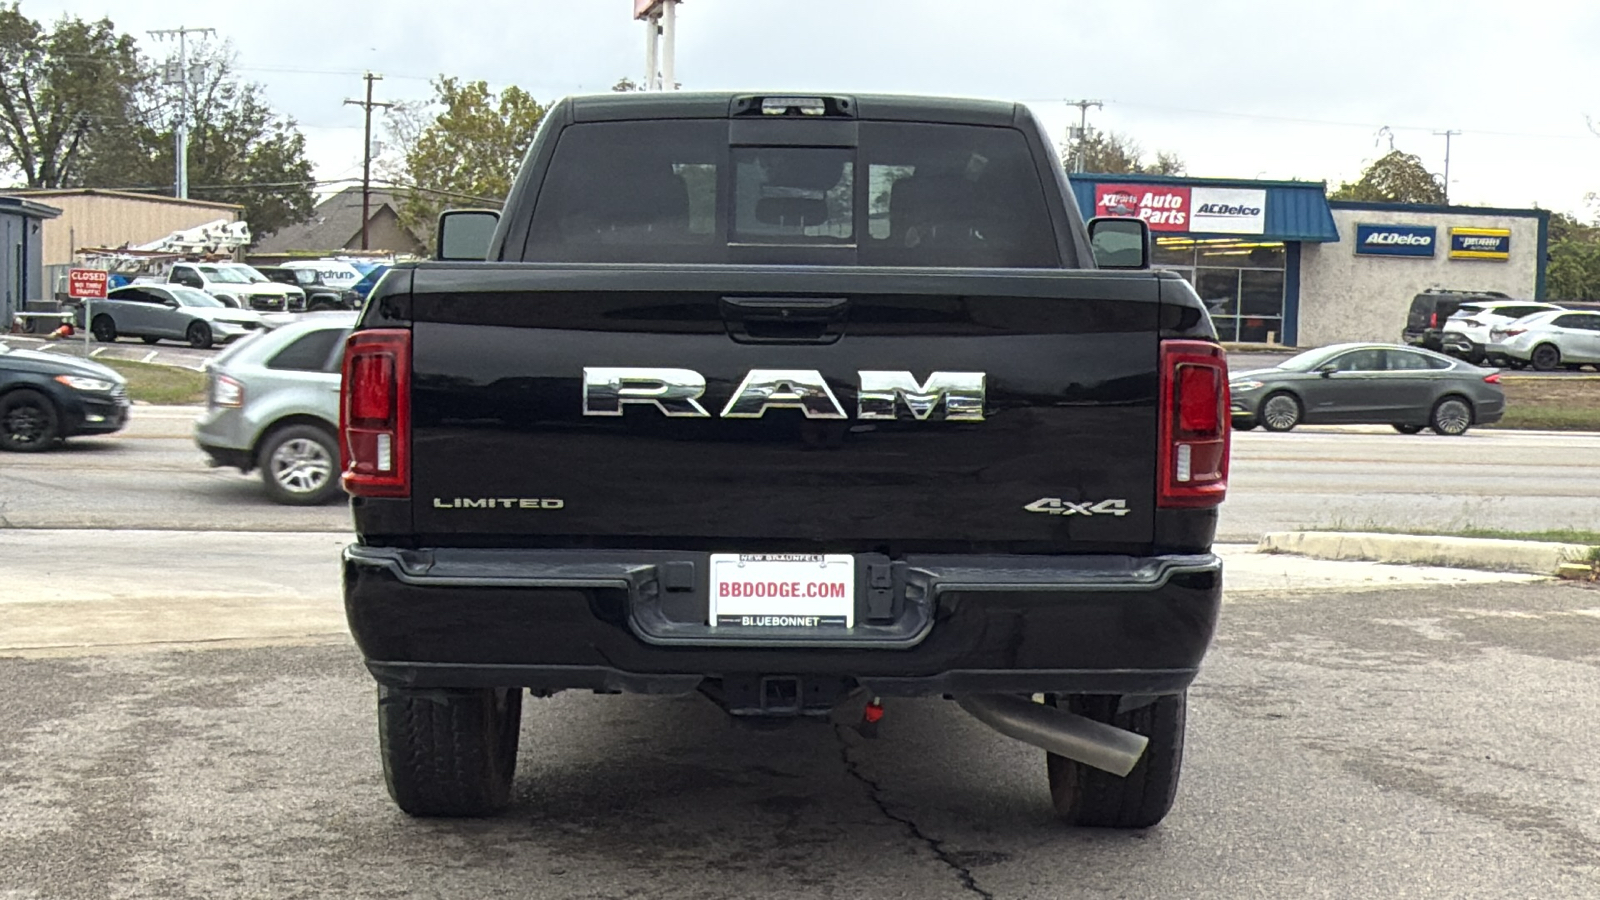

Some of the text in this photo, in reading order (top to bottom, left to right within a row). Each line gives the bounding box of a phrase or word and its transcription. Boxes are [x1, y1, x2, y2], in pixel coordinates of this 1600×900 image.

[1139, 192, 1182, 208] Auto
[1197, 203, 1261, 215] ACDelco
[1139, 208, 1186, 224] Parts
[1365, 232, 1431, 245] ACDelco
[71, 271, 106, 281] CLOSED
[582, 366, 987, 420] RAM
[433, 497, 564, 509] LIMITED
[719, 581, 846, 598] BBDODGE.COM
[741, 616, 820, 626] BLUEBONNET
